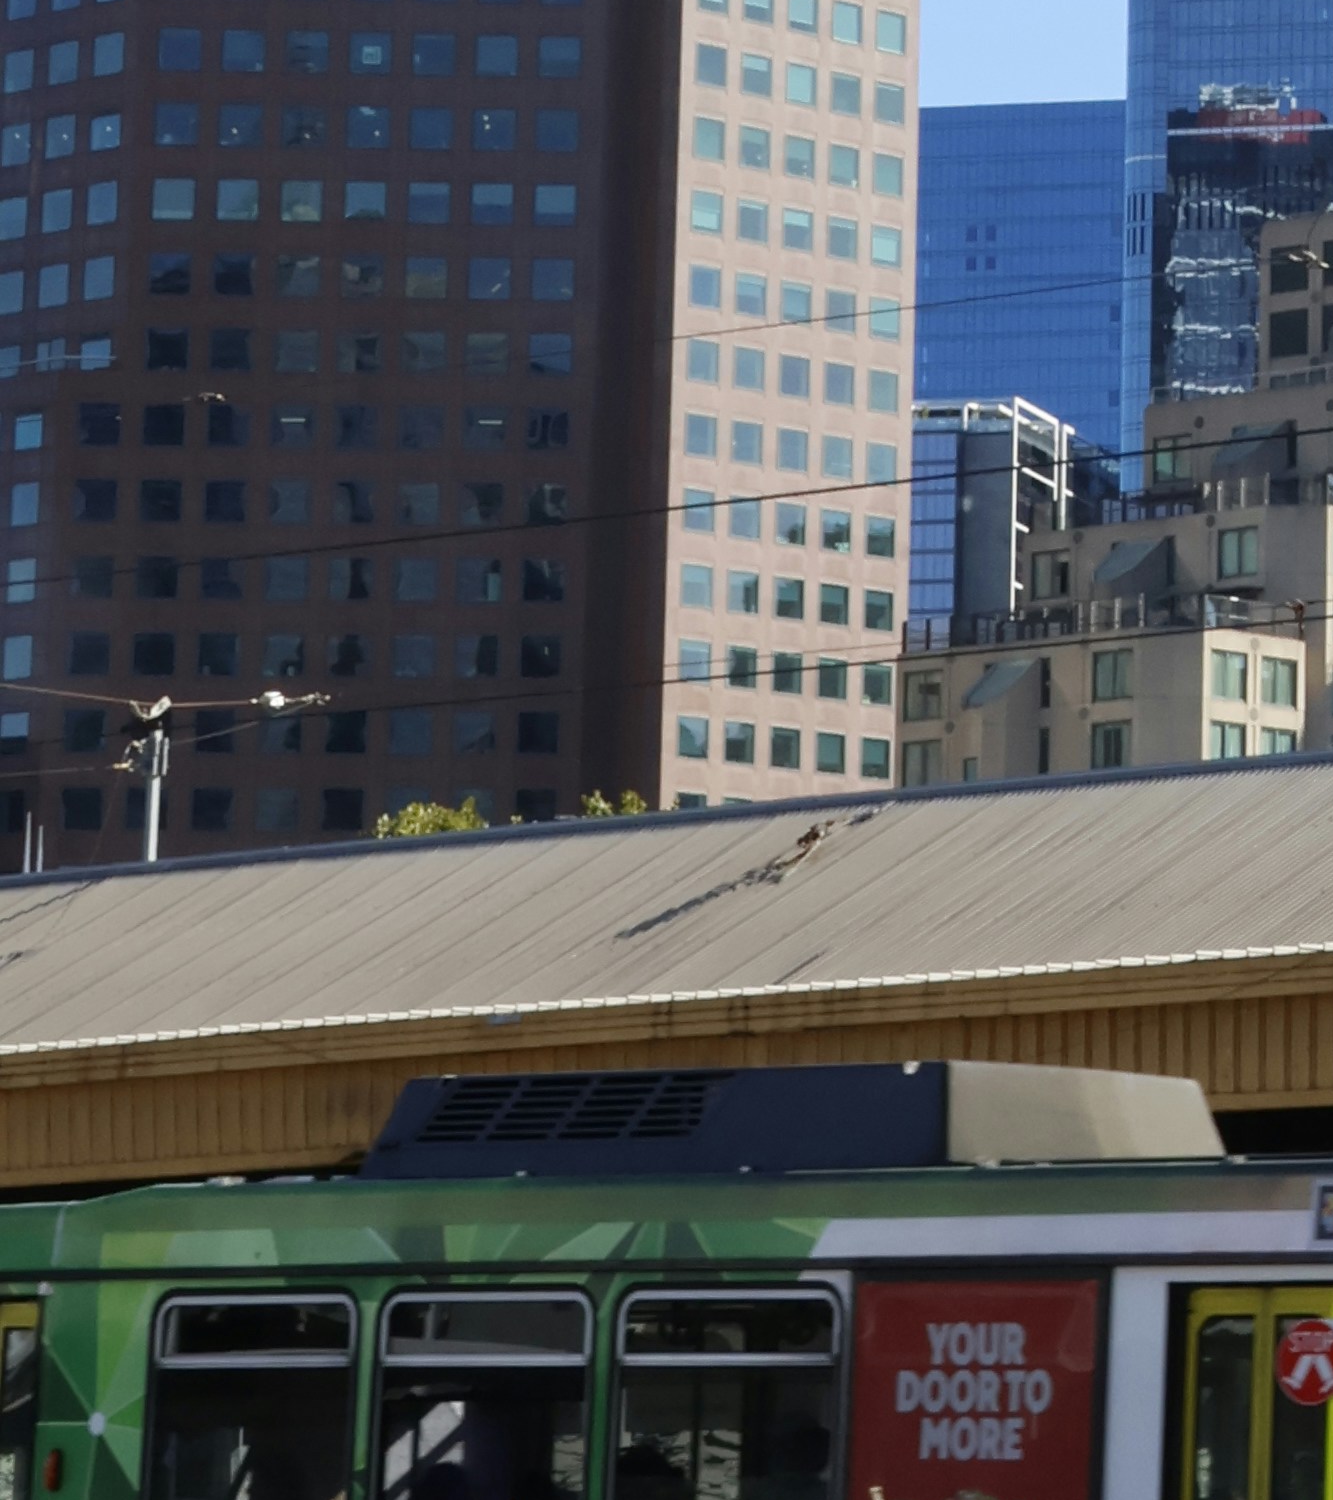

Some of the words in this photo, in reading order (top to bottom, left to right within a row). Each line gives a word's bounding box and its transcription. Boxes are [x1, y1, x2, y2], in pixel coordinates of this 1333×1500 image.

[925, 1321, 1026, 1366] YOUR
[895, 1369, 1000, 1414] DOOR
[1004, 1368, 1053, 1415] TO
[918, 1416, 1025, 1461] MORE
